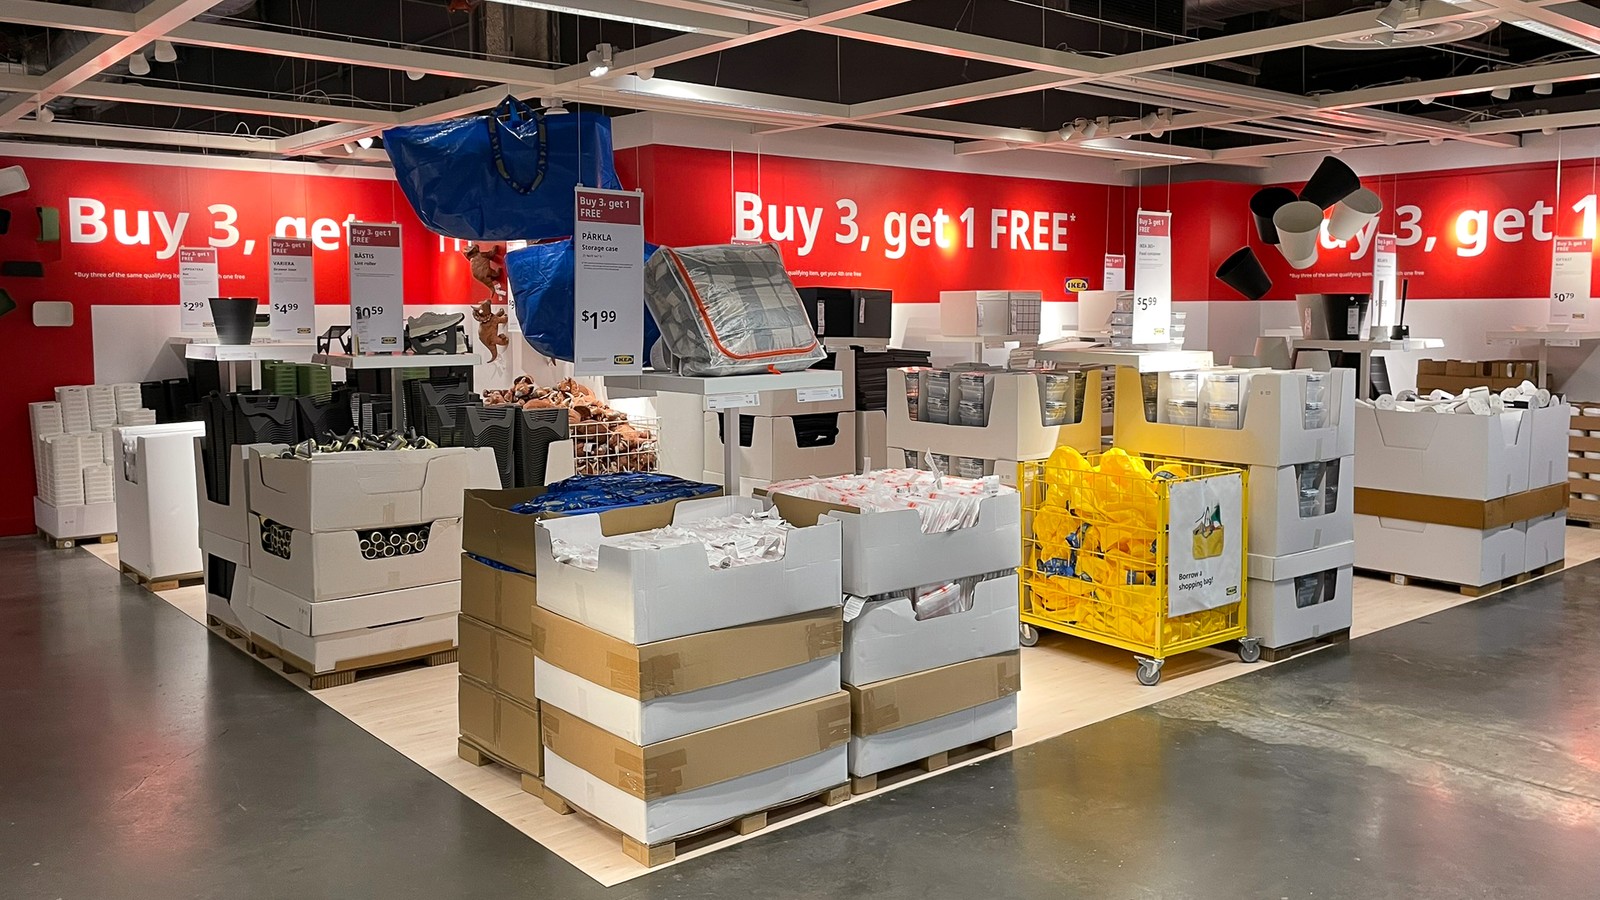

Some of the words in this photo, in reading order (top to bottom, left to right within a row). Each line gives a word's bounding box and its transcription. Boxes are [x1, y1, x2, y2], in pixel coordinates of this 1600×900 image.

[580, 197, 596, 208] Buy
[609, 201, 623, 210] get
[736, 191, 823, 256] Buy
[835, 198, 870, 252] 3,
[884, 208, 950, 259] get
[960, 207, 974, 248] 1
[1139, 218, 1148, 226] Buy
[1396, 205, 1436, 252] 3,
[1455, 200, 1553, 257] get
[1572, 194, 1597, 239] 1
[69, 197, 190, 260] Buy
[208, 204, 256, 255] 3,
[352, 228, 365, 237] Buy
[582, 231, 612, 241] PÄRKLA
[582, 244, 604, 252] Storage
[1179, 572, 1199, 580] Borrow
[1179, 580, 1202, 590] shopping
